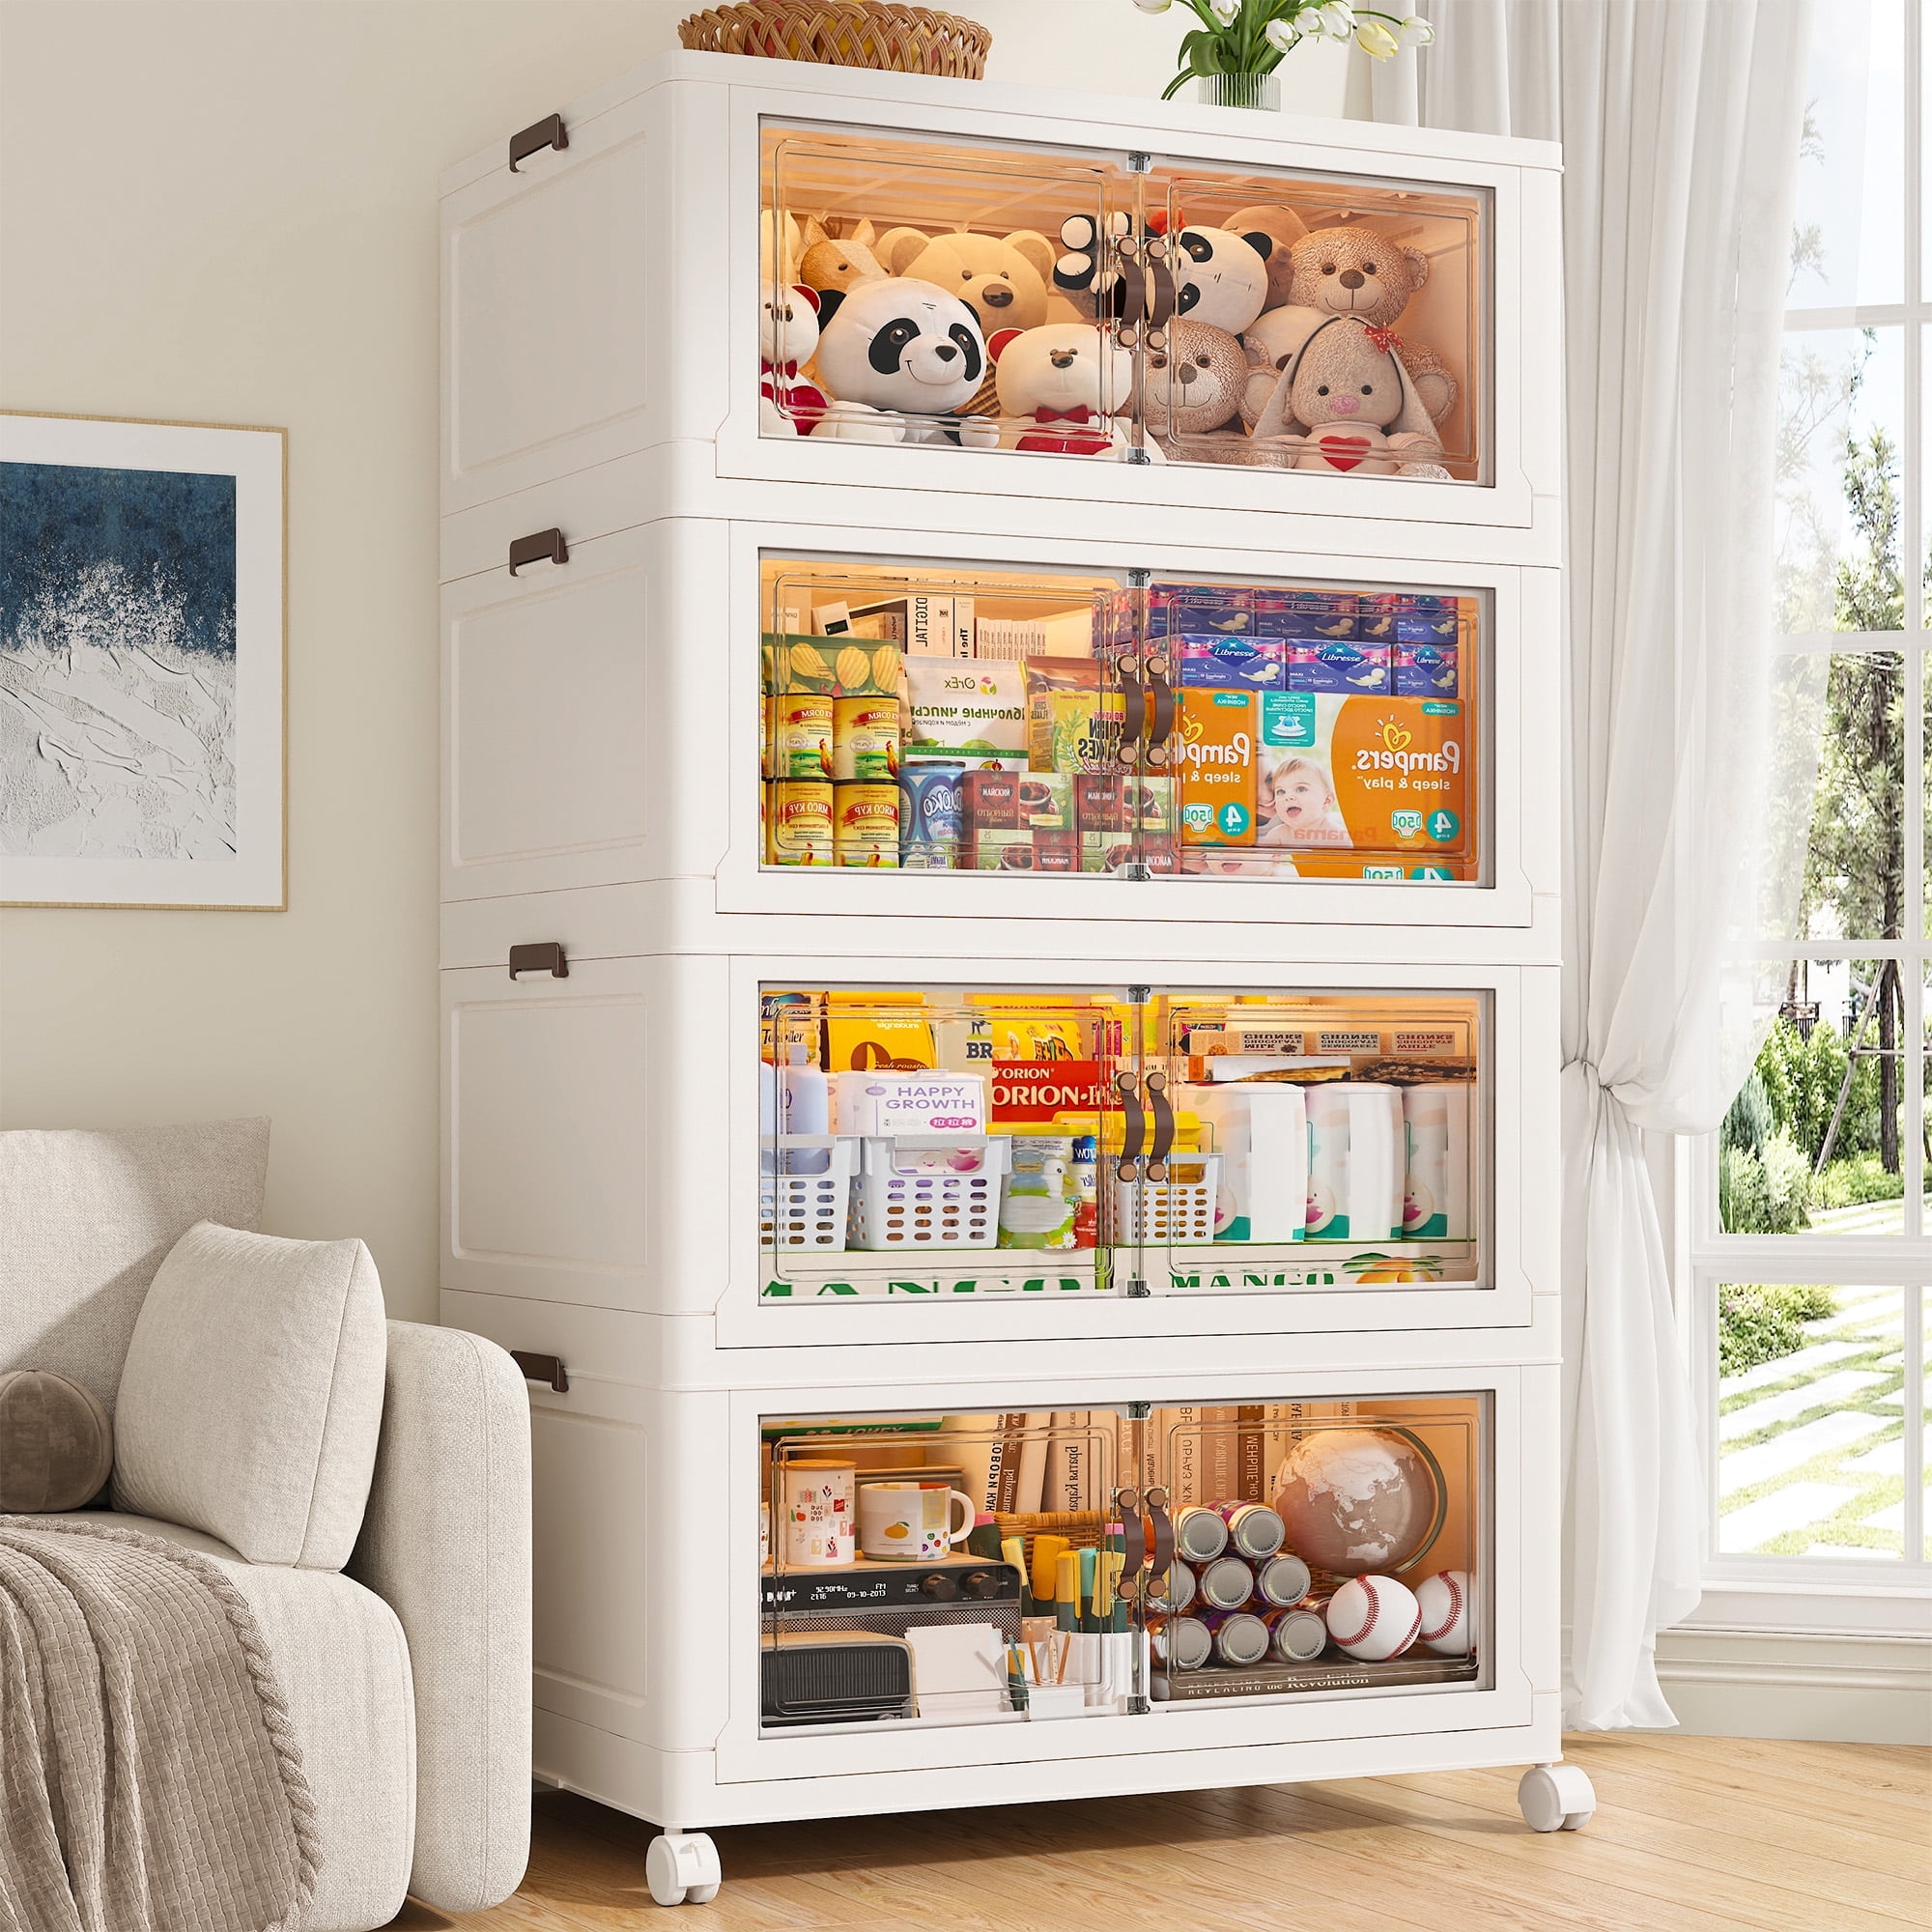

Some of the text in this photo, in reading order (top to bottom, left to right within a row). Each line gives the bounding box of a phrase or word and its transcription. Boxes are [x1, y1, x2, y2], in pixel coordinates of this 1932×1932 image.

[1214, 648, 1254, 657] Libresse
[1321, 653, 1361, 662] Libresse
[897, 1087, 964, 1097] HAPPY
[886, 1099, 975, 1110] GROWTH
